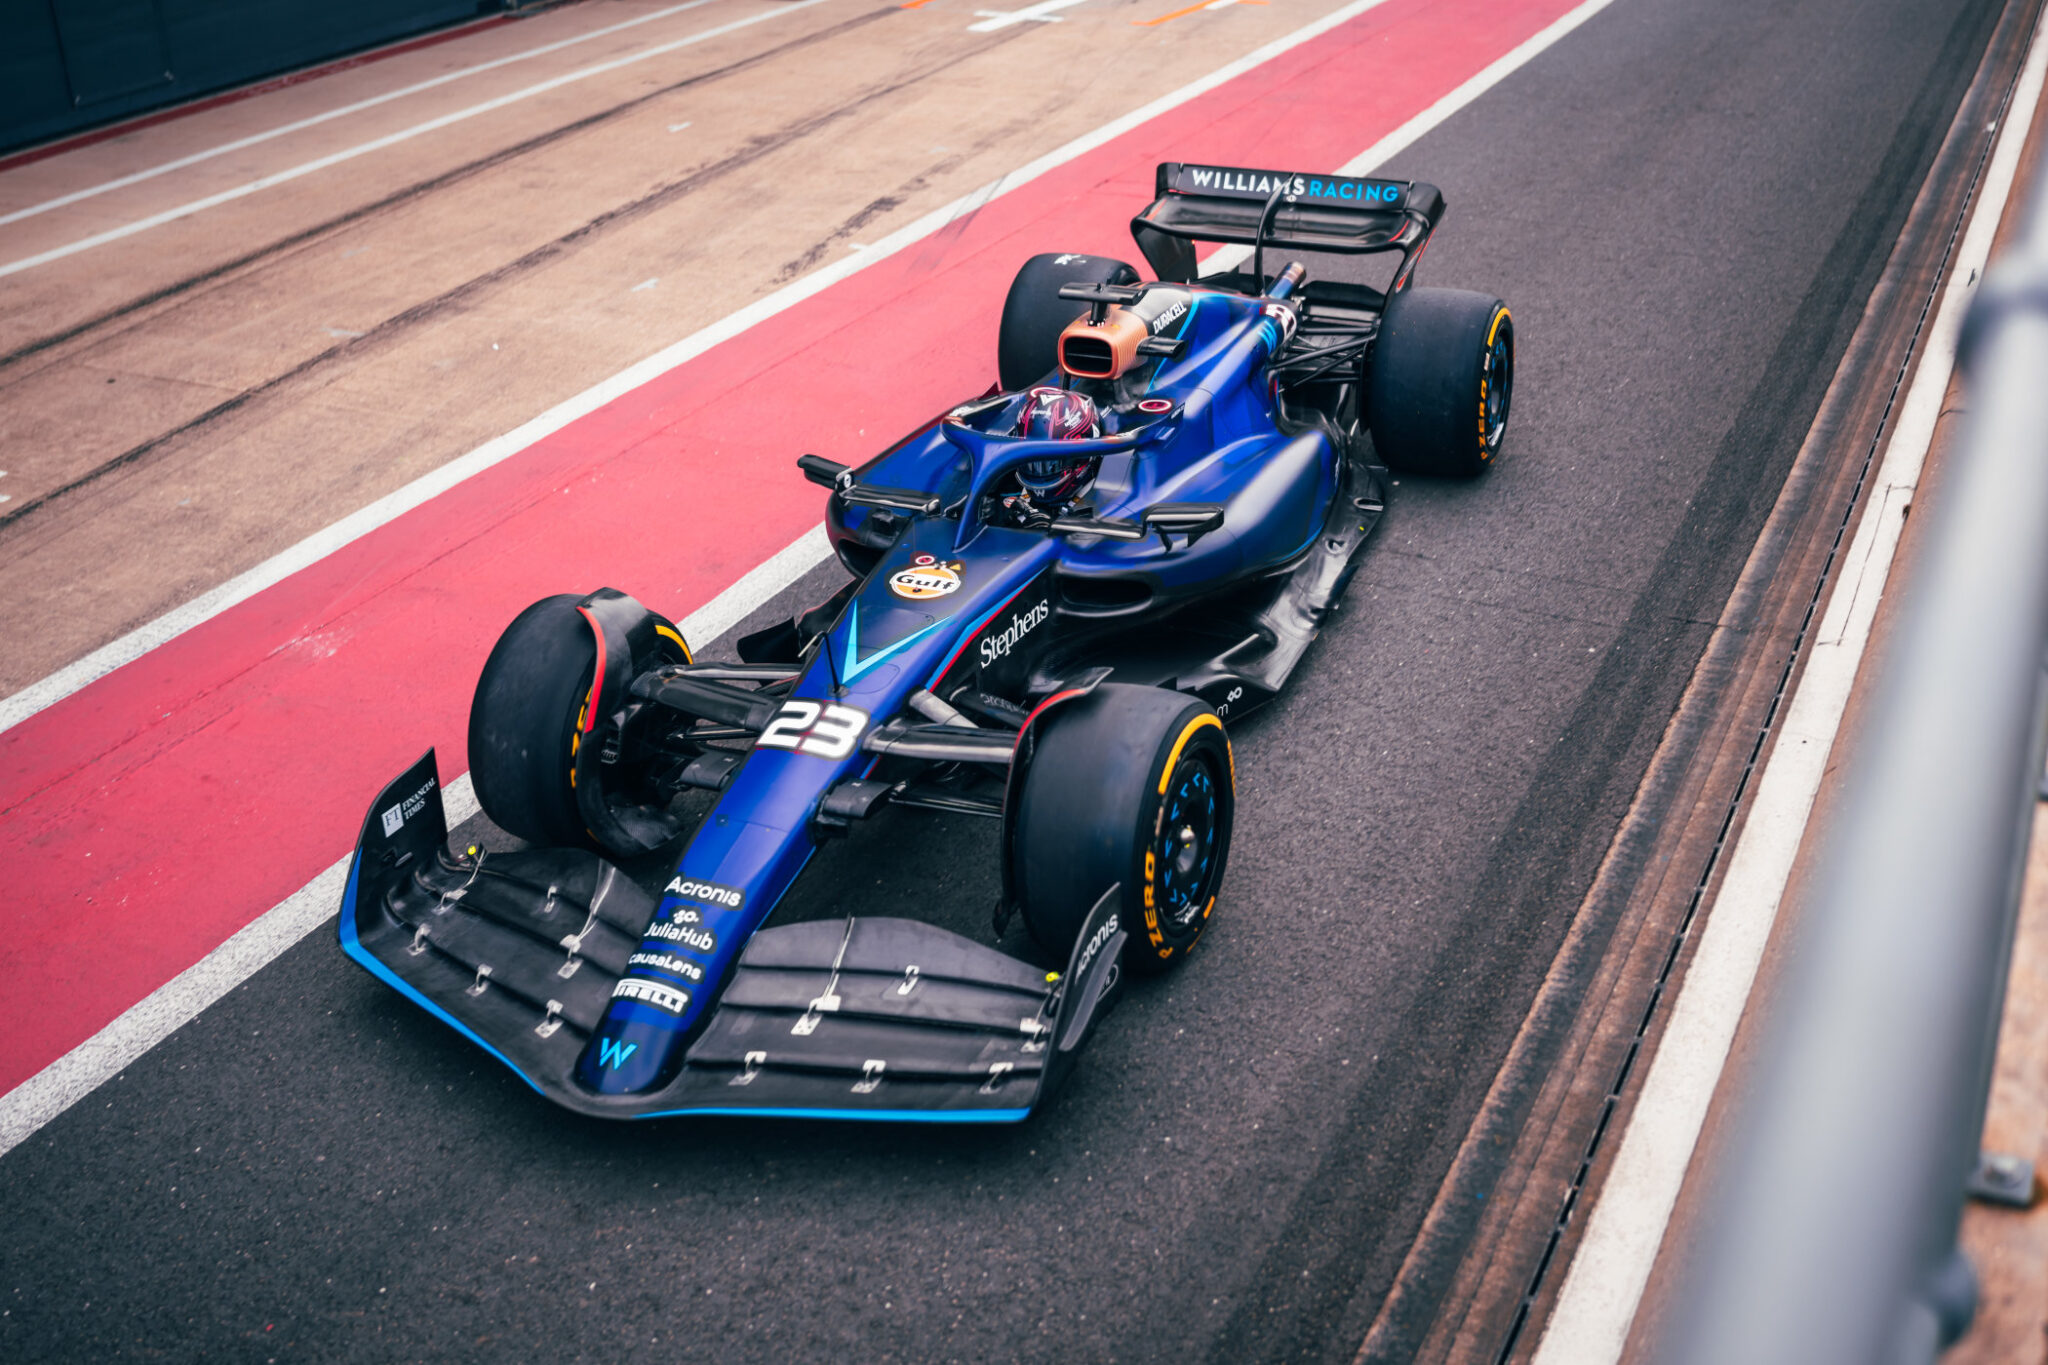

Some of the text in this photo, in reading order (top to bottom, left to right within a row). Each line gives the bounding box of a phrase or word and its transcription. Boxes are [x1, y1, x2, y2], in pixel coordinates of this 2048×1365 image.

[1192, 169, 1399, 202] WILLIAMS RACING
[1152, 300, 1187, 335] DURACELL
[896, 574, 955, 590] Gulf
[980, 599, 1049, 669] Stephens
[755, 701, 867, 759] 23
[402, 777, 437, 811] FINANCIAL
[403, 798, 426, 820] TIMES
[664, 876, 742, 907] Acronis
[1144, 851, 1164, 948] ZERO
[643, 922, 714, 951] JuliaHub
